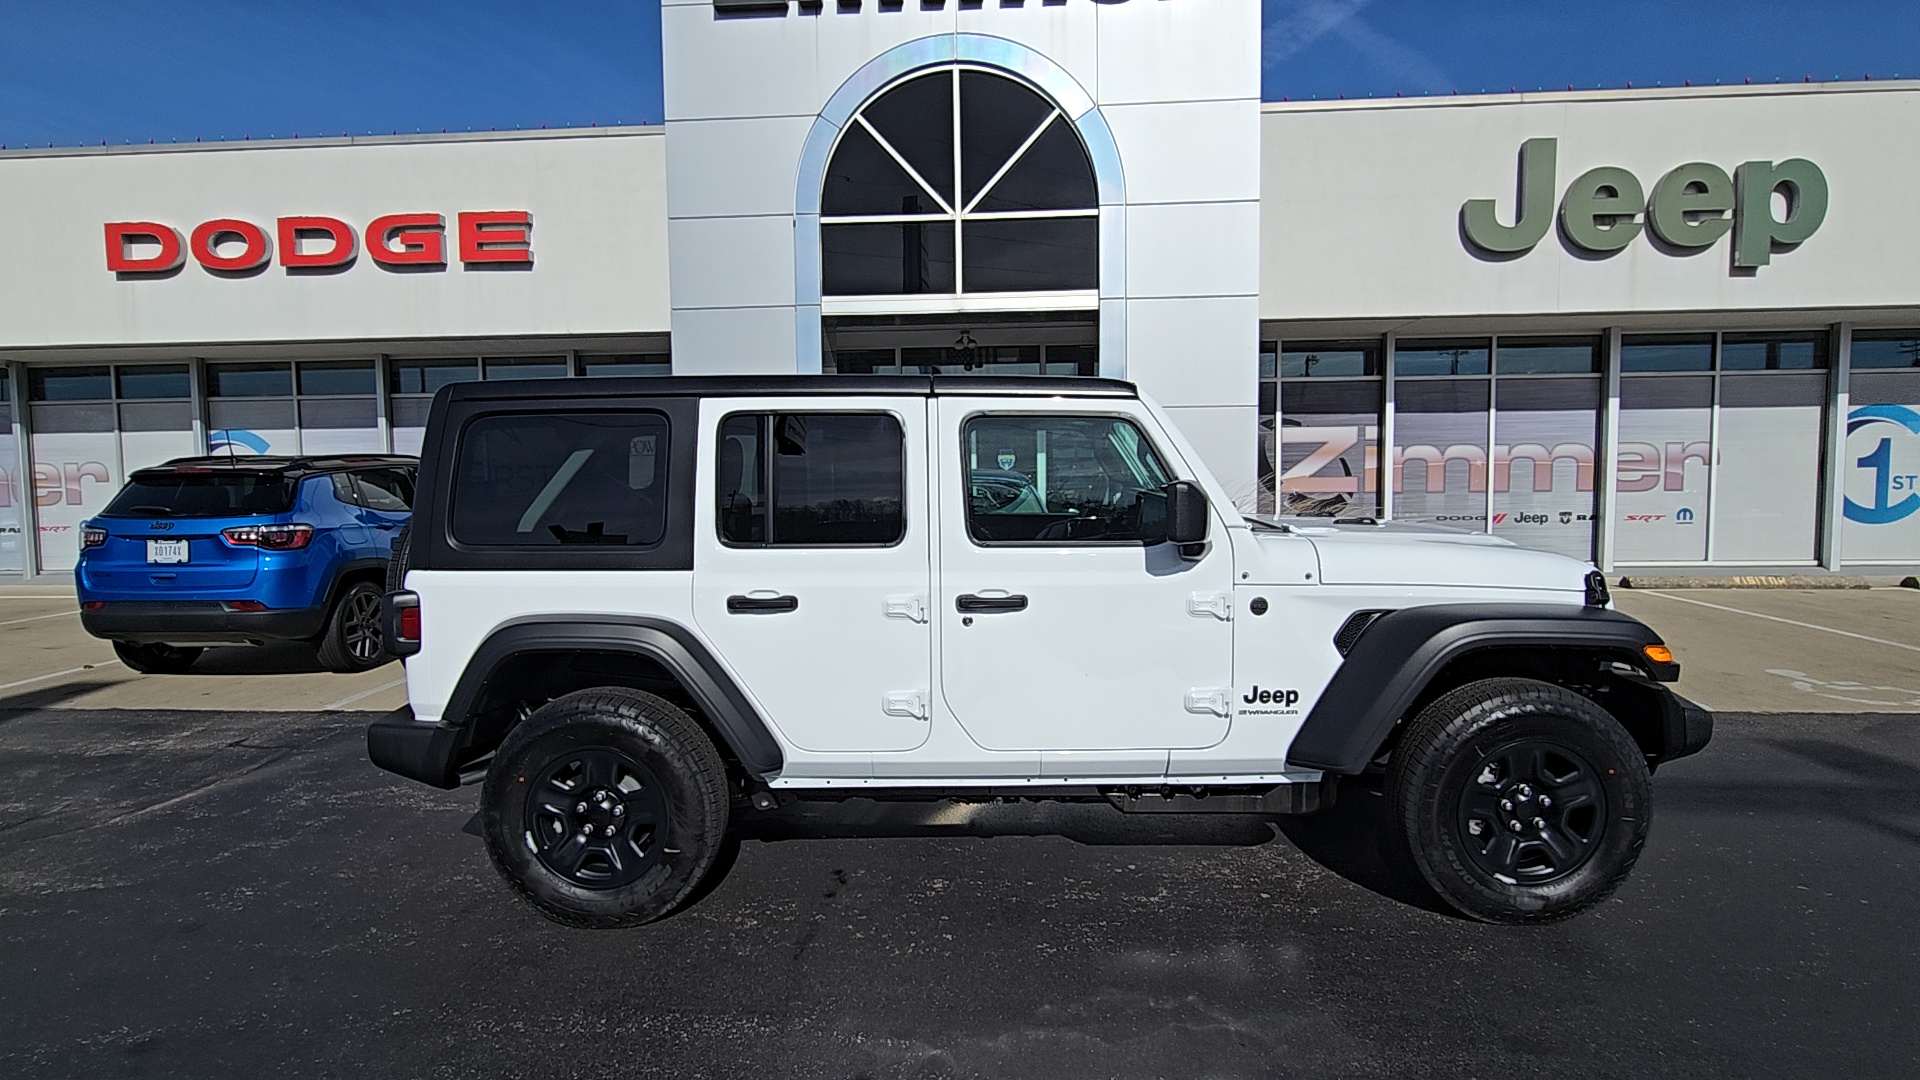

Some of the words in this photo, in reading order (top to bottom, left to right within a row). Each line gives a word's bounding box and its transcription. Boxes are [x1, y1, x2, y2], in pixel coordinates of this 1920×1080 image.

[1460, 137, 1829, 272] Jeep
[103, 211, 535, 281] DODGE
[1280, 425, 1721, 493] Zimmer
[1513, 511, 1549, 525] Jeep
[1623, 514, 1667, 523] SRT
[1243, 685, 1299, 708] Jeep
